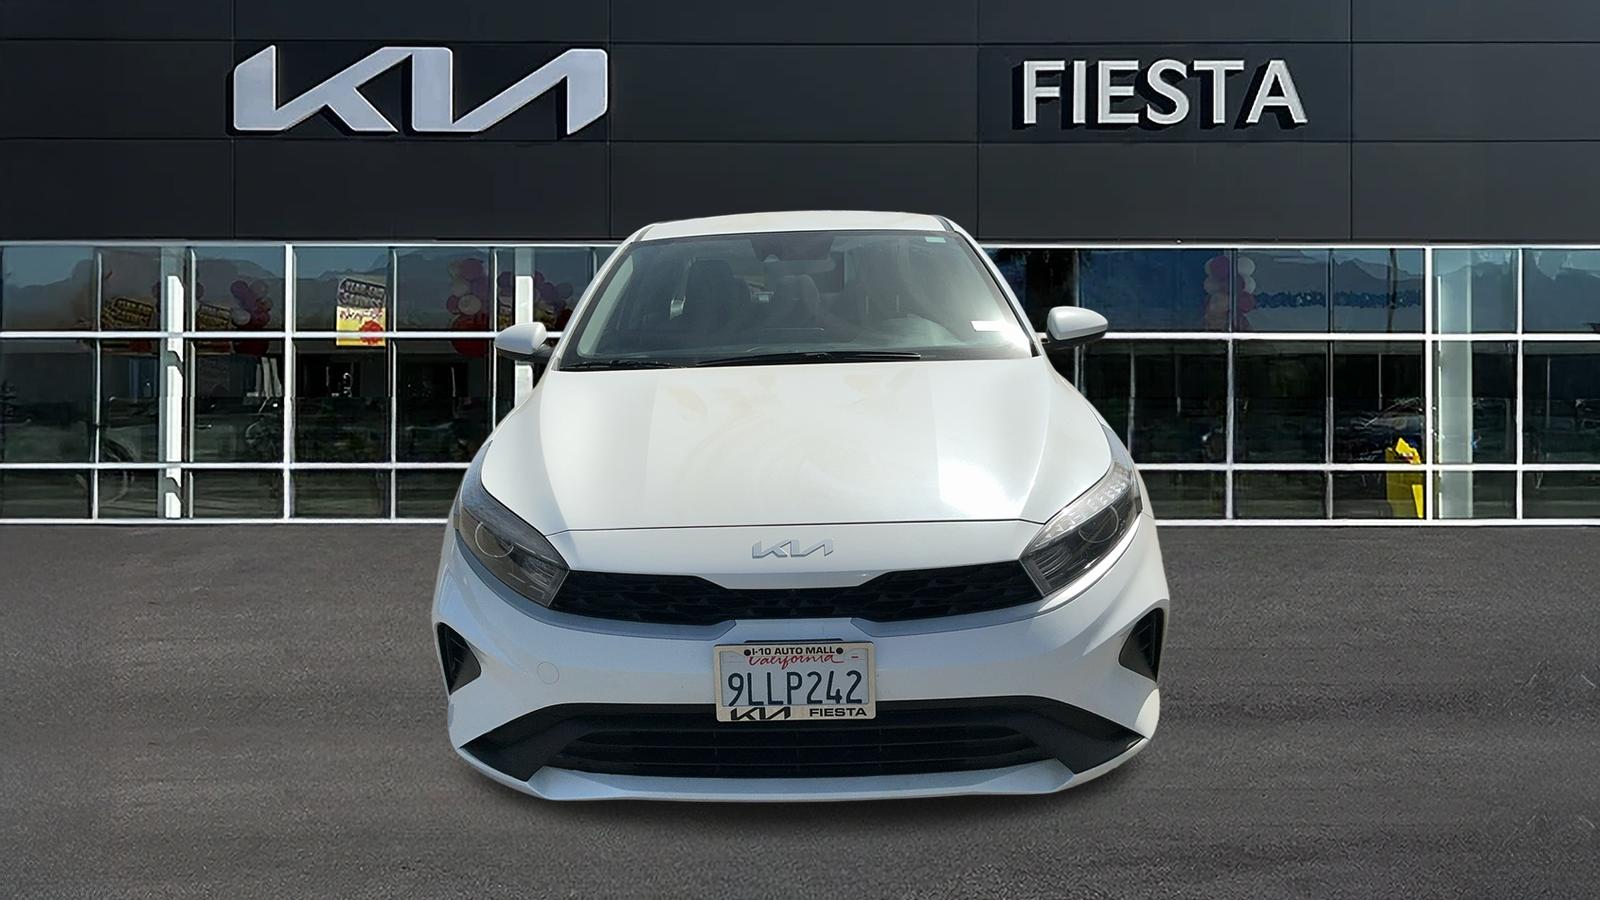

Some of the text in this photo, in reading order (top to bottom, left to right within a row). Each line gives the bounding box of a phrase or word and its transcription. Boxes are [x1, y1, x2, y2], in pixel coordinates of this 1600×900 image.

[233, 44, 608, 135] KIA
[1023, 58, 1308, 124] FIESTA
[752, 539, 833, 558] KIA
[774, 647, 803, 655] AUTO
[806, 646, 835, 654] MALL
[728, 670, 862, 706] 9LLP242
[730, 706, 867, 720] KIA FIESTA
